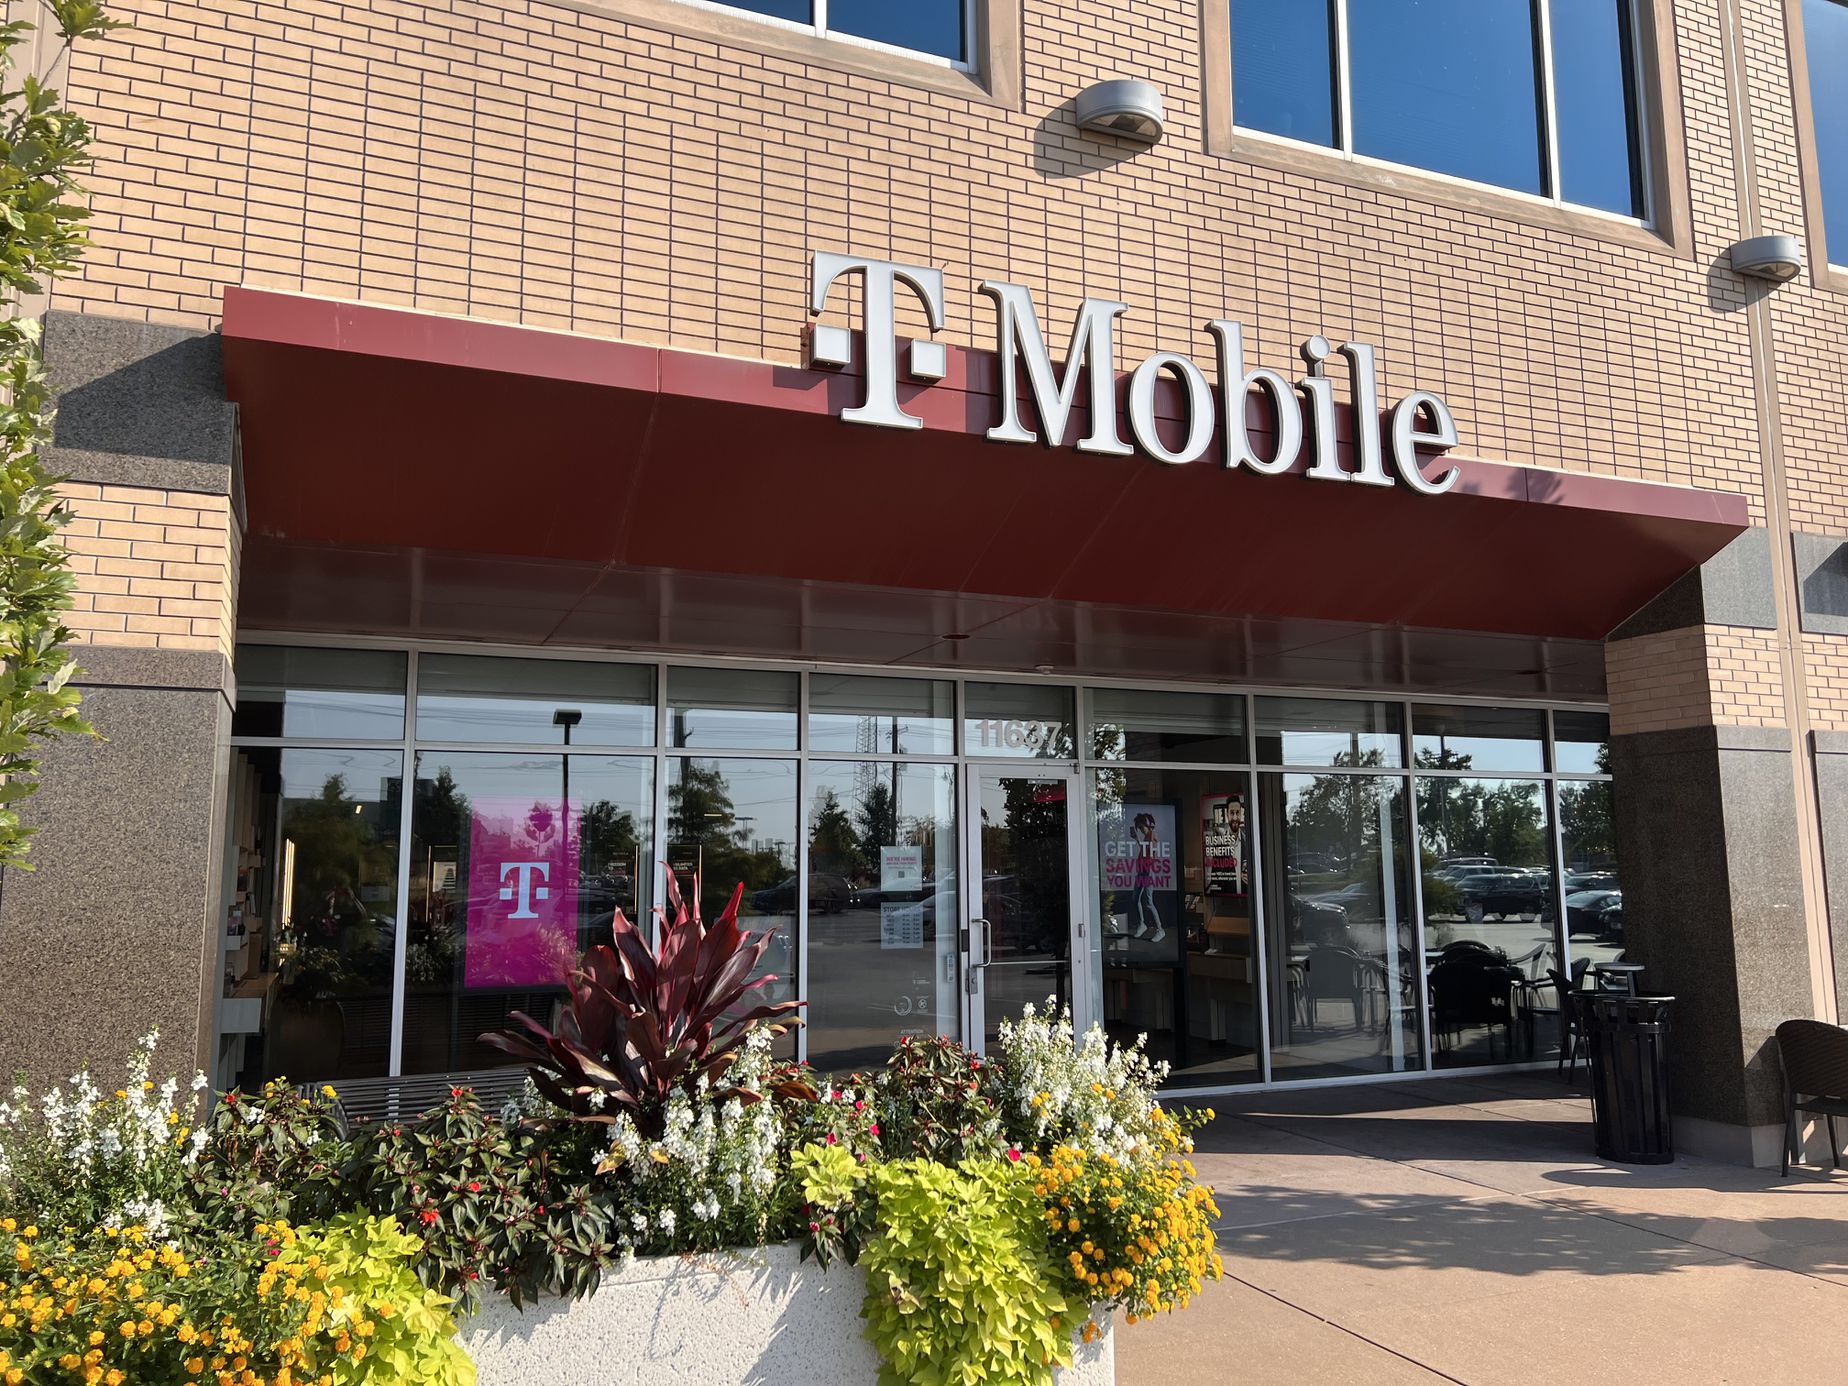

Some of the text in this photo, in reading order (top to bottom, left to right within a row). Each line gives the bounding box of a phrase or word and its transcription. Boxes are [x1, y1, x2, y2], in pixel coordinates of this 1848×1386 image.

[979, 279, 1461, 494] Mobile
[975, 719, 1062, 749] 11637
[1206, 834, 1236, 846] BUSINESS
[1105, 841, 1170, 857] GET THE
[1206, 846, 1235, 857] BENEFITS
[1106, 858, 1171, 873] SAVINGS
[1206, 857, 1238, 868] INCLUDED
[1107, 876, 1171, 888] YOU WANT
